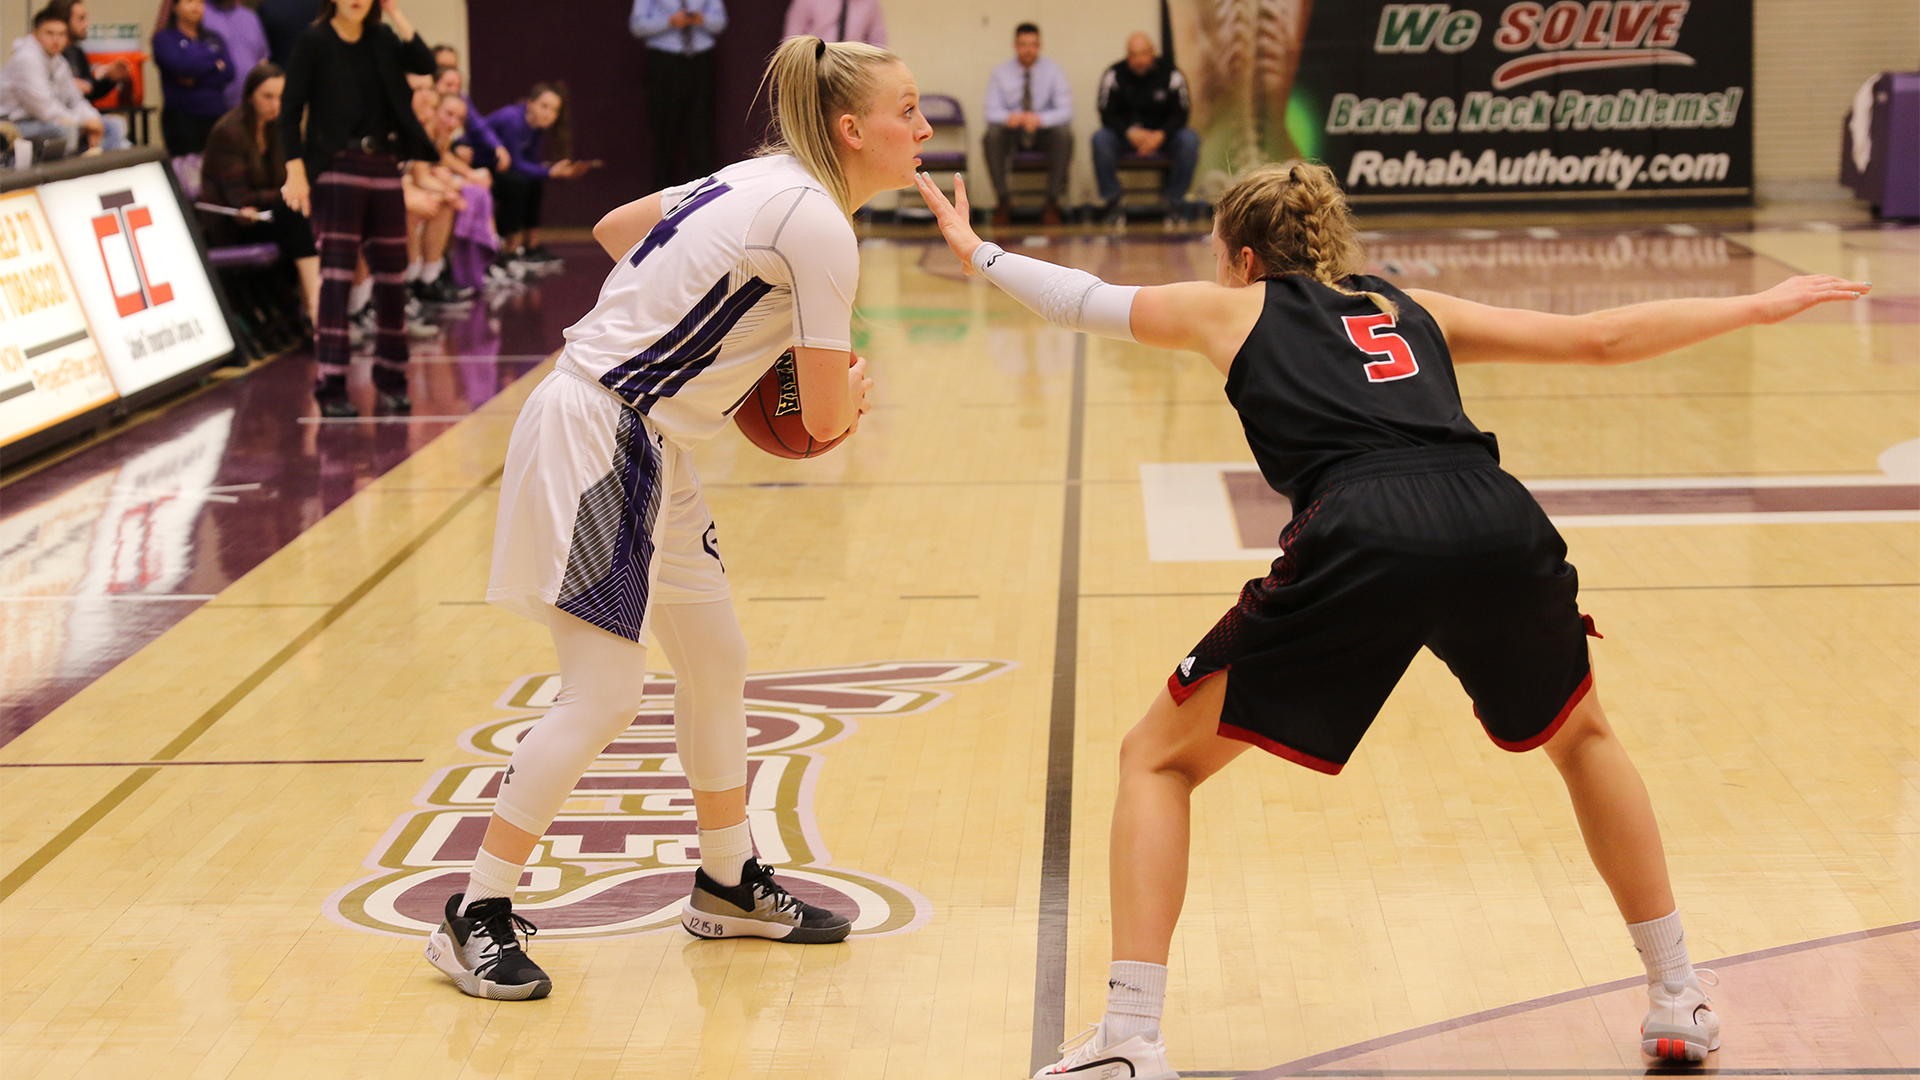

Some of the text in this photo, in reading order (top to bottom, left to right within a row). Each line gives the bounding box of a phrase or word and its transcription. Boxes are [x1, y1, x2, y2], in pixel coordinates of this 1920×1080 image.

[1374, 0, 1690, 53] We SOLVE
[1326, 87, 1744, 134] Back & Neck Problems!
[1347, 148, 1731, 191] RehabAuthority.com
[1341, 311, 1420, 382] 5
[774, 351, 802, 417] NAIA
